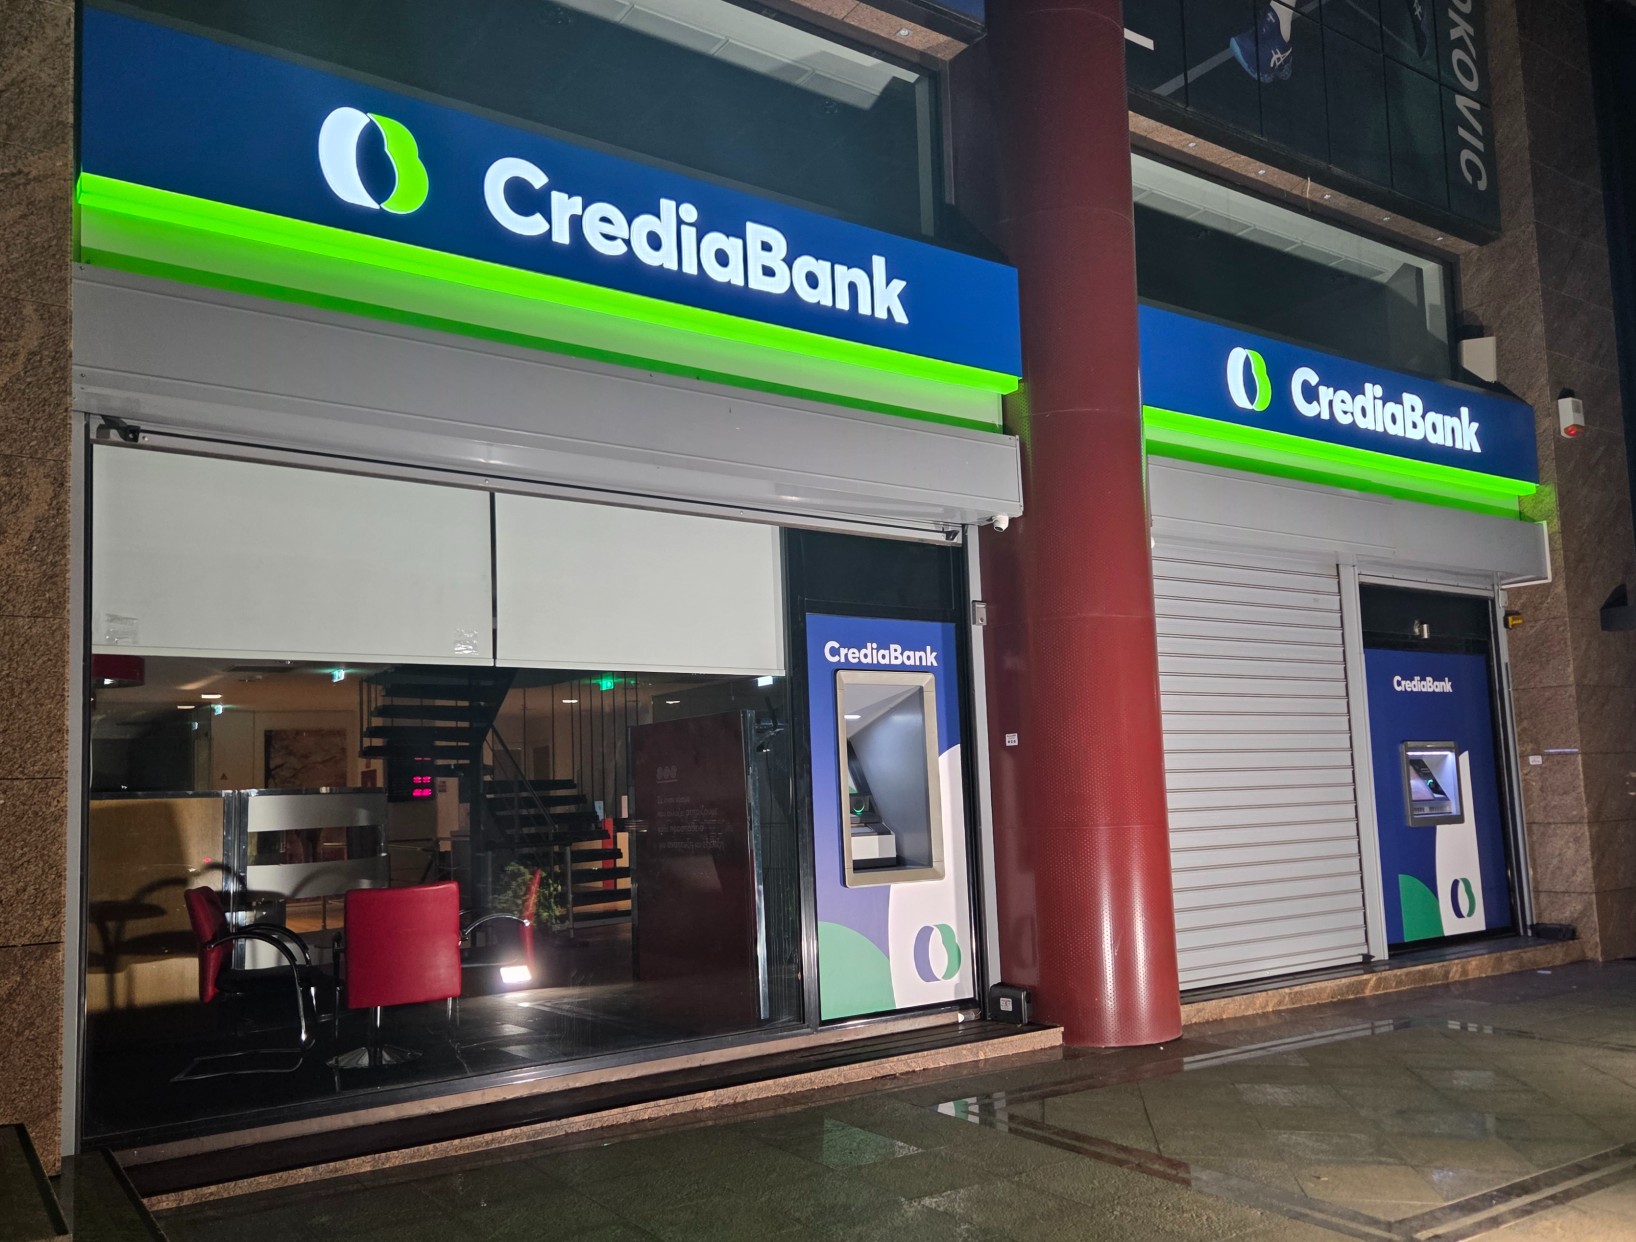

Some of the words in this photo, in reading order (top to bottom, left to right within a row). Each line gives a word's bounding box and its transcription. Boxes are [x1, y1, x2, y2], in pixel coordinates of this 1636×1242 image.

[483, 156, 909, 325] CrediaBank
[1291, 366, 1482, 453] CrediaBank
[824, 640, 938, 667] CrediaBank
[1393, 675, 1453, 693] CrediaBank
